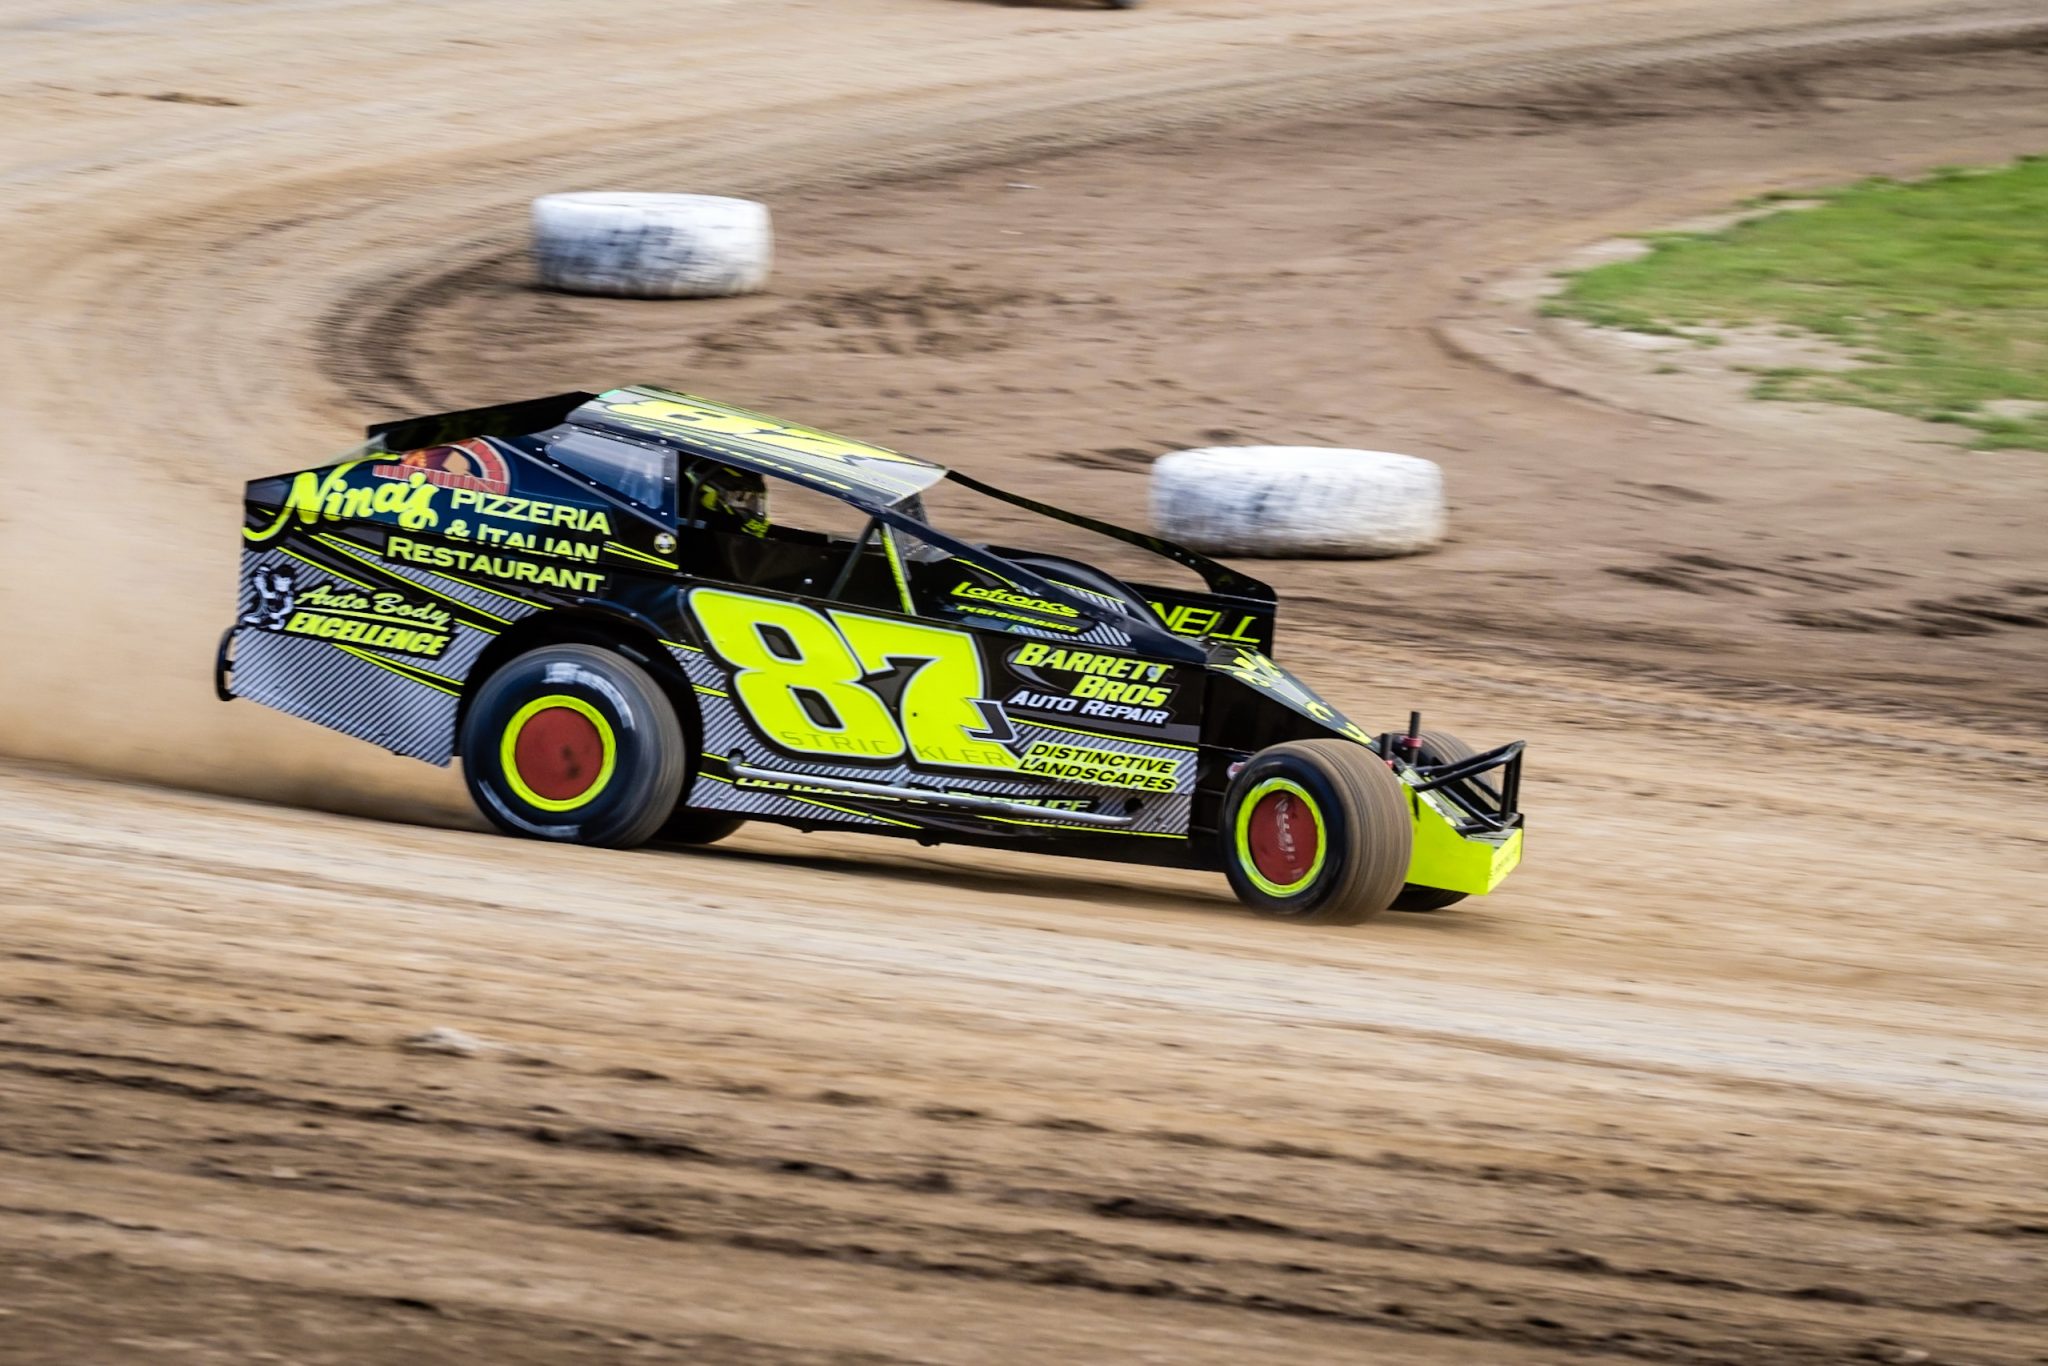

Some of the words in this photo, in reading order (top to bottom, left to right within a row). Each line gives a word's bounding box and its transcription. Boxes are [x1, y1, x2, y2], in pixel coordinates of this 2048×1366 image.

[242, 452, 440, 542] Nina's
[451, 487, 612, 536] PIZZERIA
[387, 535, 606, 593] RESTAURANT
[444, 519, 471, 543] &
[477, 522, 600, 564] ITALIAN
[294, 584, 369, 611] Auto
[373, 591, 452, 629] Body
[284, 612, 450, 657] EXCELLENCE
[1012, 642, 1174, 684] BARRETT
[1007, 689, 1079, 713] AUTO
[1079, 699, 1170, 725] REPAIR
[1069, 674, 1173, 708] BROS
[1018, 758, 1179, 791] LANDSCAPES
[1030, 744, 1176, 774] DISTINCTIVE
